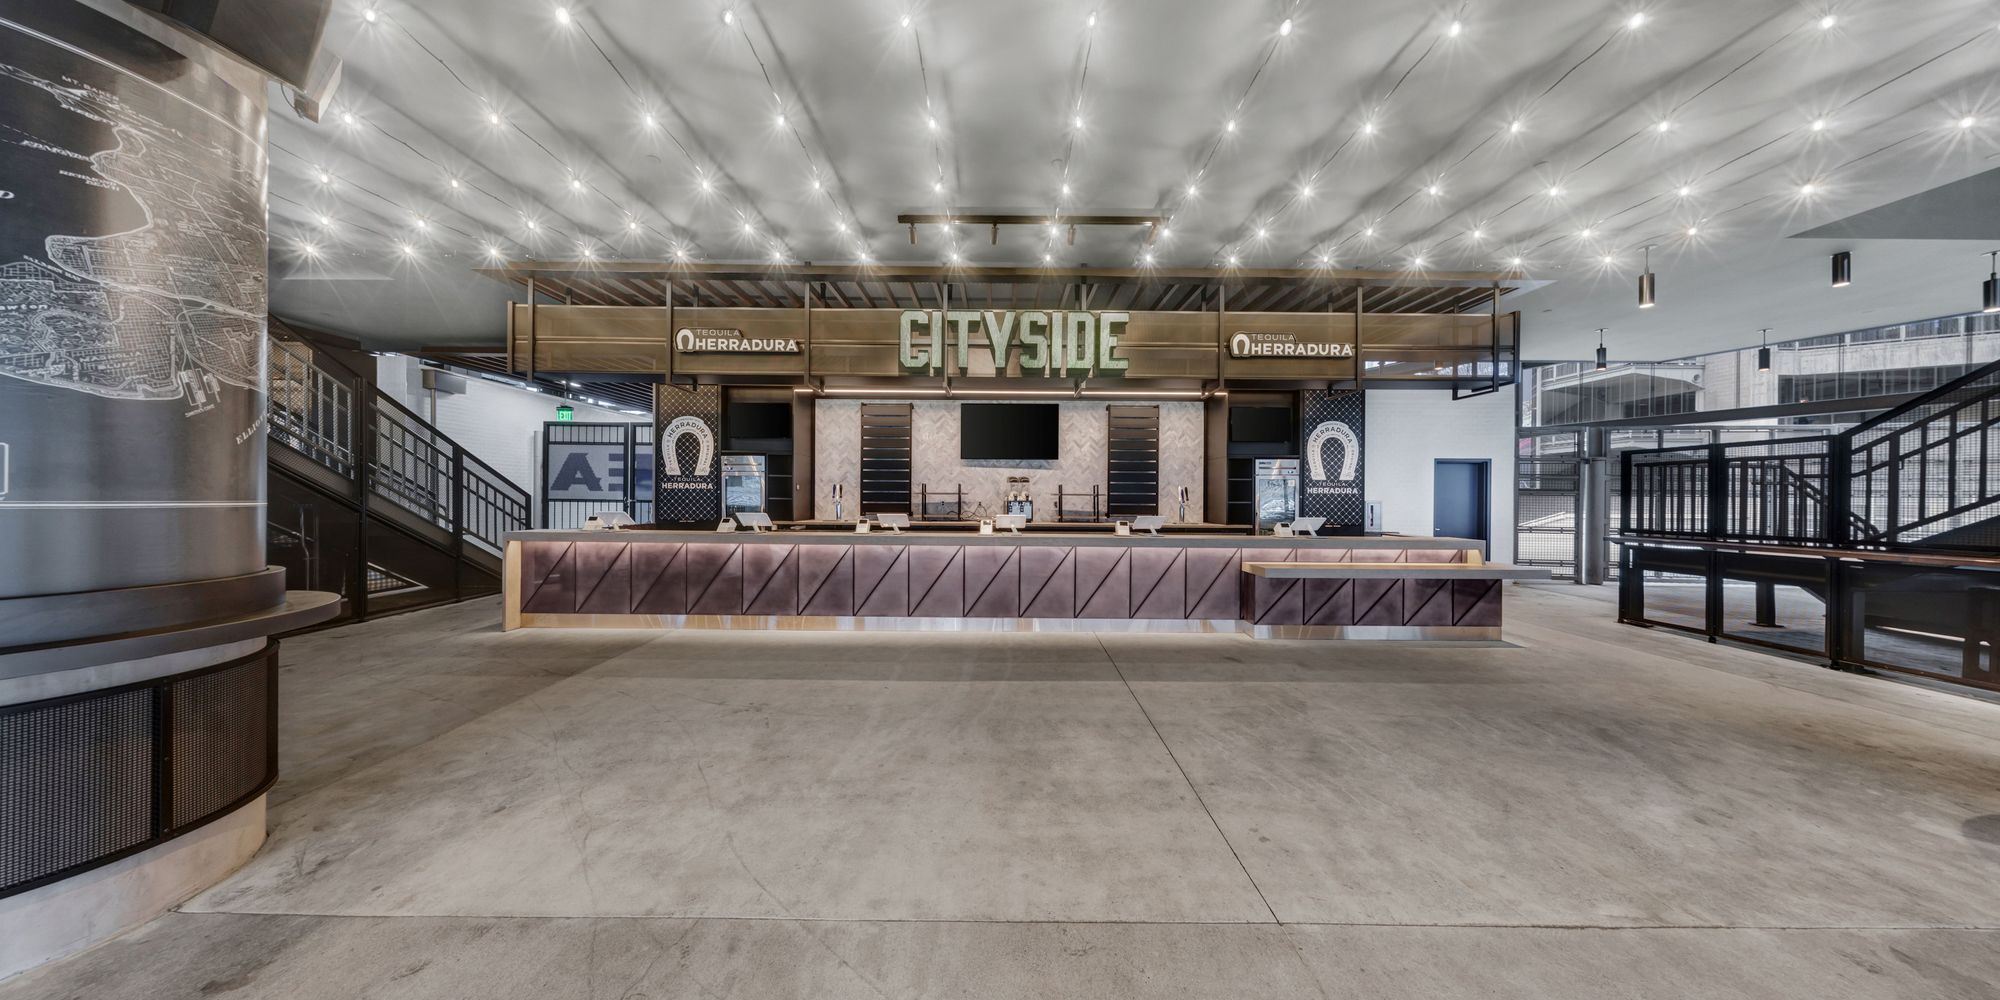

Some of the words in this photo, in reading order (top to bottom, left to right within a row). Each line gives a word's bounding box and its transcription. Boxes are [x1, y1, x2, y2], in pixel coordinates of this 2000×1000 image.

[900, 309, 1130, 370] CITYSIDE
[1251, 333, 1295, 341] TEQUILA
[695, 338, 799, 352] HERRADURA
[1251, 342, 1353, 356] HERRADURA
[667, 421, 708, 439] HERRADURA
[1313, 426, 1353, 443] HERRADURA
[661, 482, 714, 490] HERRADURA
[1307, 487, 1358, 495] HERRADURA
